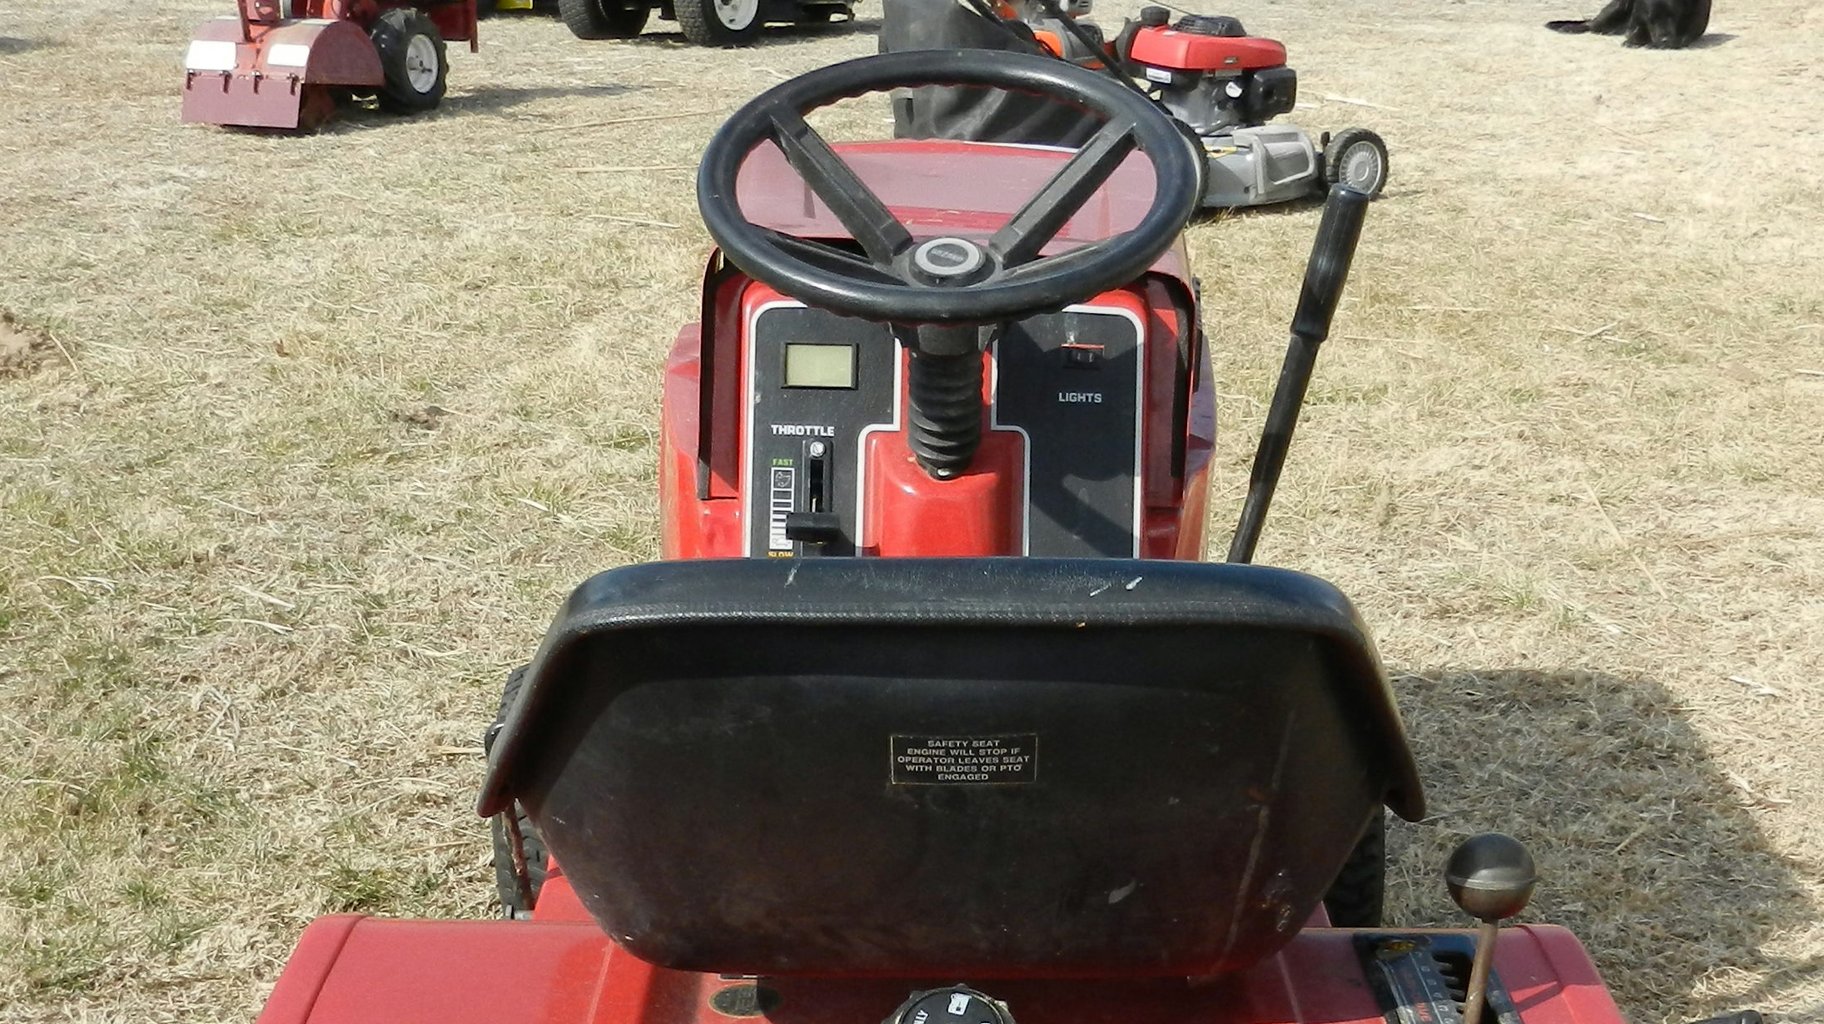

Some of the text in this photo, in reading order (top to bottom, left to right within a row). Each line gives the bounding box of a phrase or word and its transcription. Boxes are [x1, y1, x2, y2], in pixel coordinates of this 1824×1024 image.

[1058, 392, 1102, 403] LIGHTS
[770, 424, 835, 437] THROTTLE
[772, 458, 793, 466] FAST
[927, 740, 1000, 748] SAFETY SEAT
[907, 748, 946, 756] ENGINE
[979, 748, 1008, 756] STOP
[1010, 747, 1021, 755] IF
[897, 755, 955, 764] OPERATOR
[1002, 755, 1030, 764] SEAT
[905, 764, 932, 772] WITH
[936, 765, 978, 773] BLADES
[1000, 764, 1023, 772] PTO
[937, 773, 989, 781] ENGAGED
